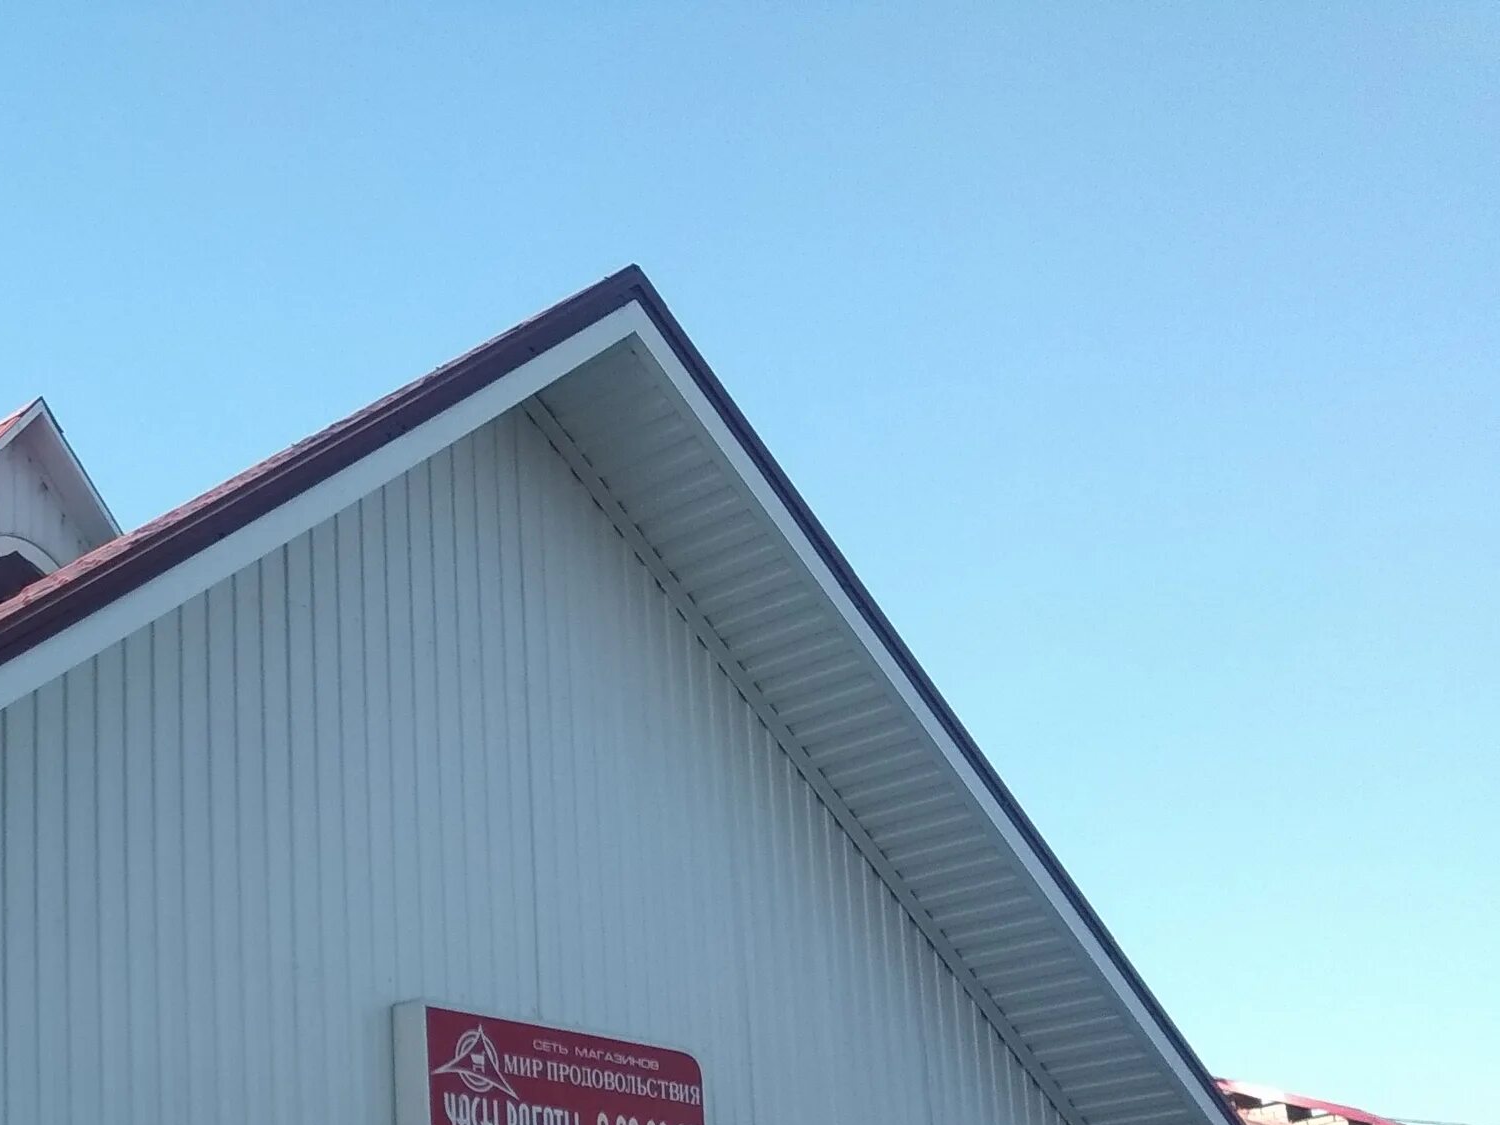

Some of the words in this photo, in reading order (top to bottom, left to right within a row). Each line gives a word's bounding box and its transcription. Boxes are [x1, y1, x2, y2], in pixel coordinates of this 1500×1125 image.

[532, 1038, 569, 1056] СЕТЬ
[574, 1045, 660, 1071] МАГАЗИНОВ
[503, 1054, 543, 1080] МИР
[546, 1061, 701, 1106] ПРОДОВОЛЬСТВИЯ
